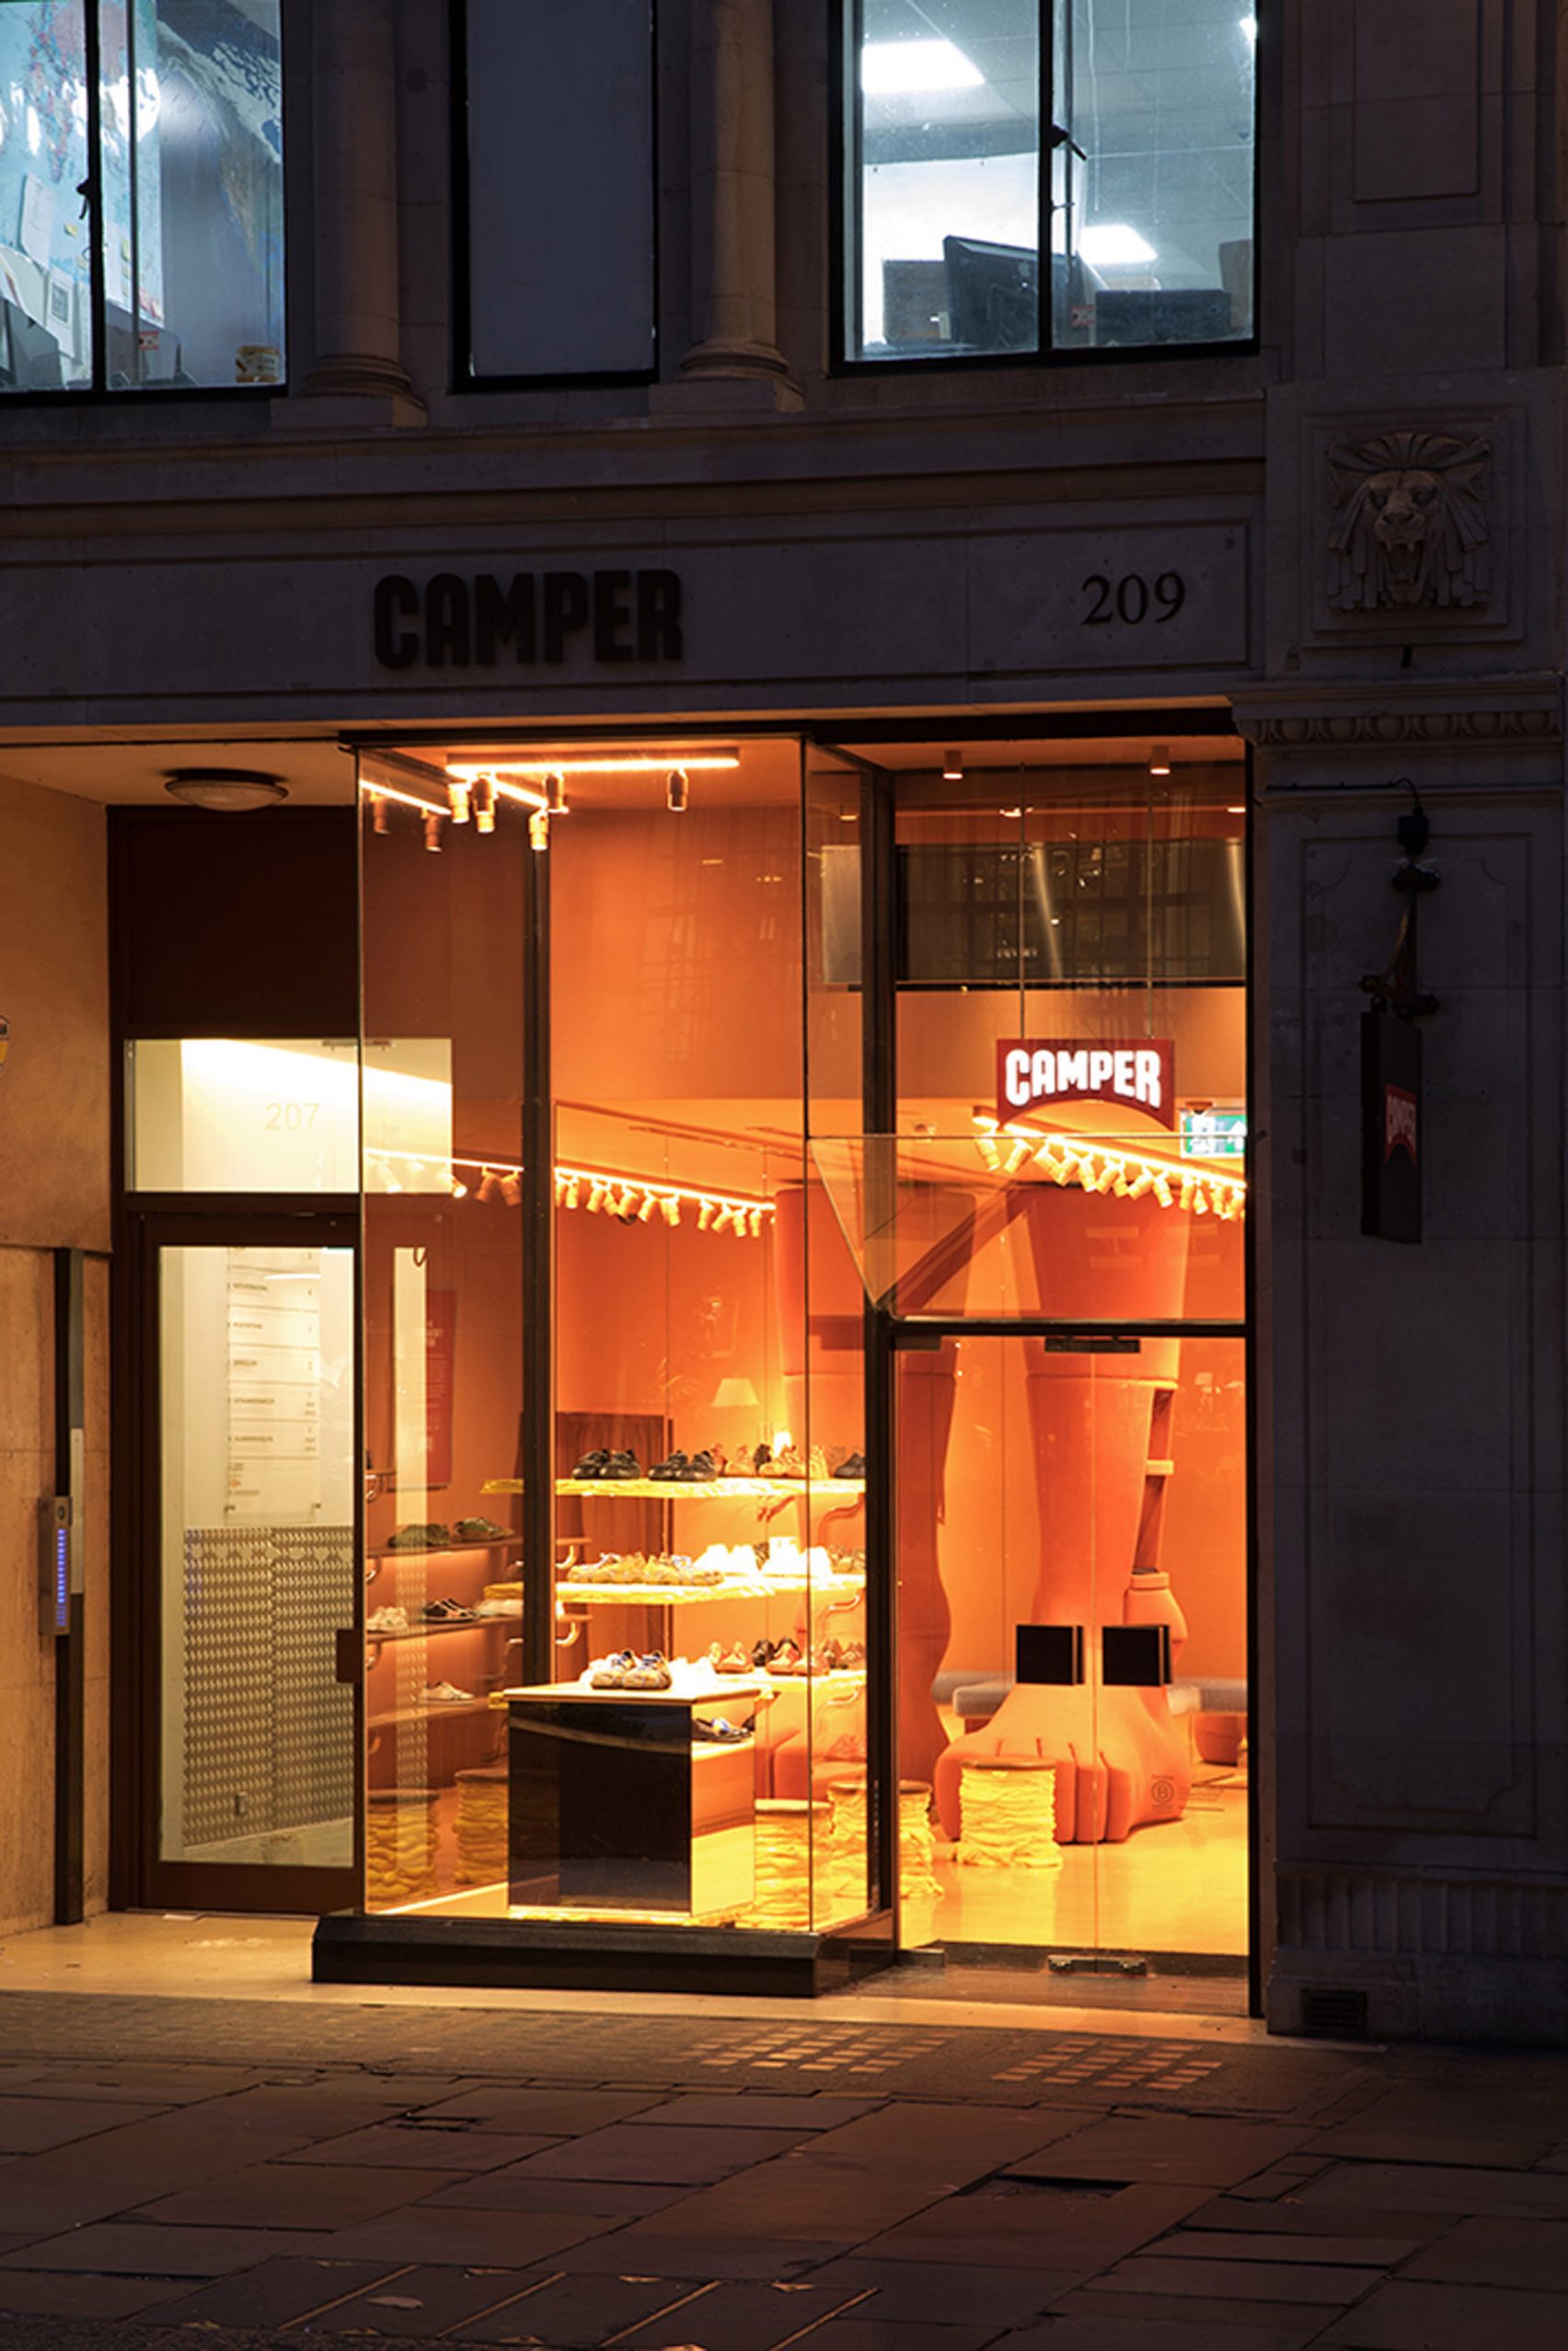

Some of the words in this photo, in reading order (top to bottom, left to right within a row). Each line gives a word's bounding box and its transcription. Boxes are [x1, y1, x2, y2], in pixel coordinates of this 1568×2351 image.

[375, 570, 683, 669] CAMPER
[1081, 572, 1185, 625] 209
[1006, 1049, 1161, 1109] CAMPER
[265, 1102, 320, 1131] 207
